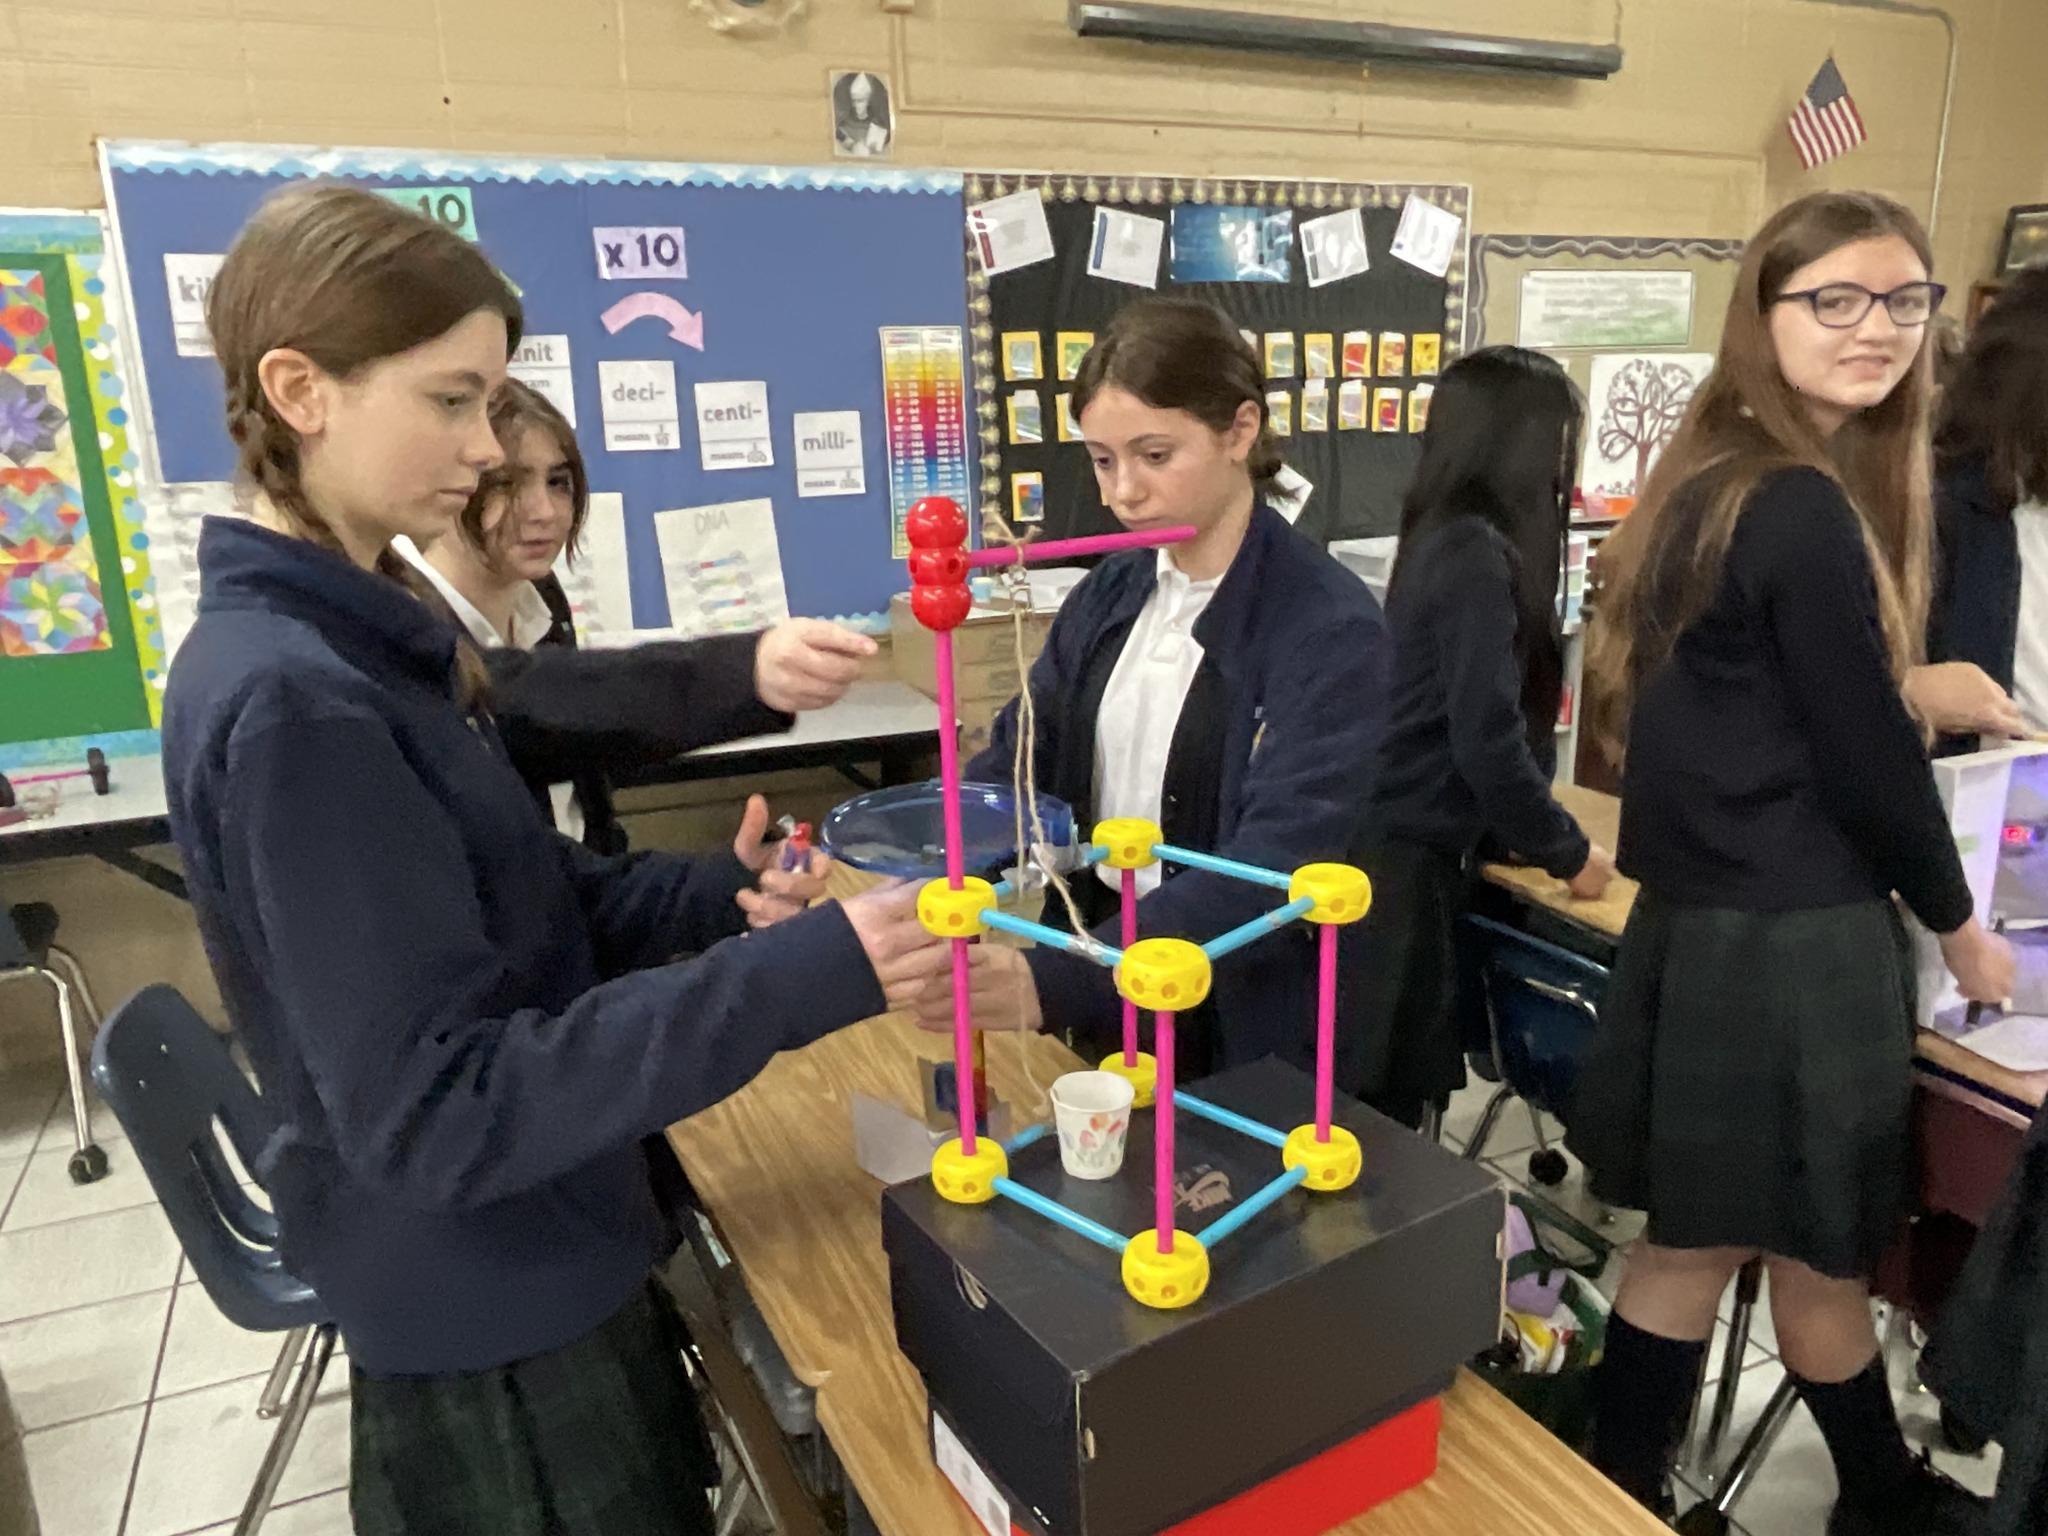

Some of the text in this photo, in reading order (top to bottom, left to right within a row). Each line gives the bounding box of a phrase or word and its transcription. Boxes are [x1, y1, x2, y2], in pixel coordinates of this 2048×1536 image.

[417, 193, 467, 230] 10
[602, 233, 679, 268] x 10
[177, 275, 212, 302] ki
[612, 381, 666, 402] deci-
[703, 401, 762, 423] centi-
[802, 431, 855, 451] milli-
